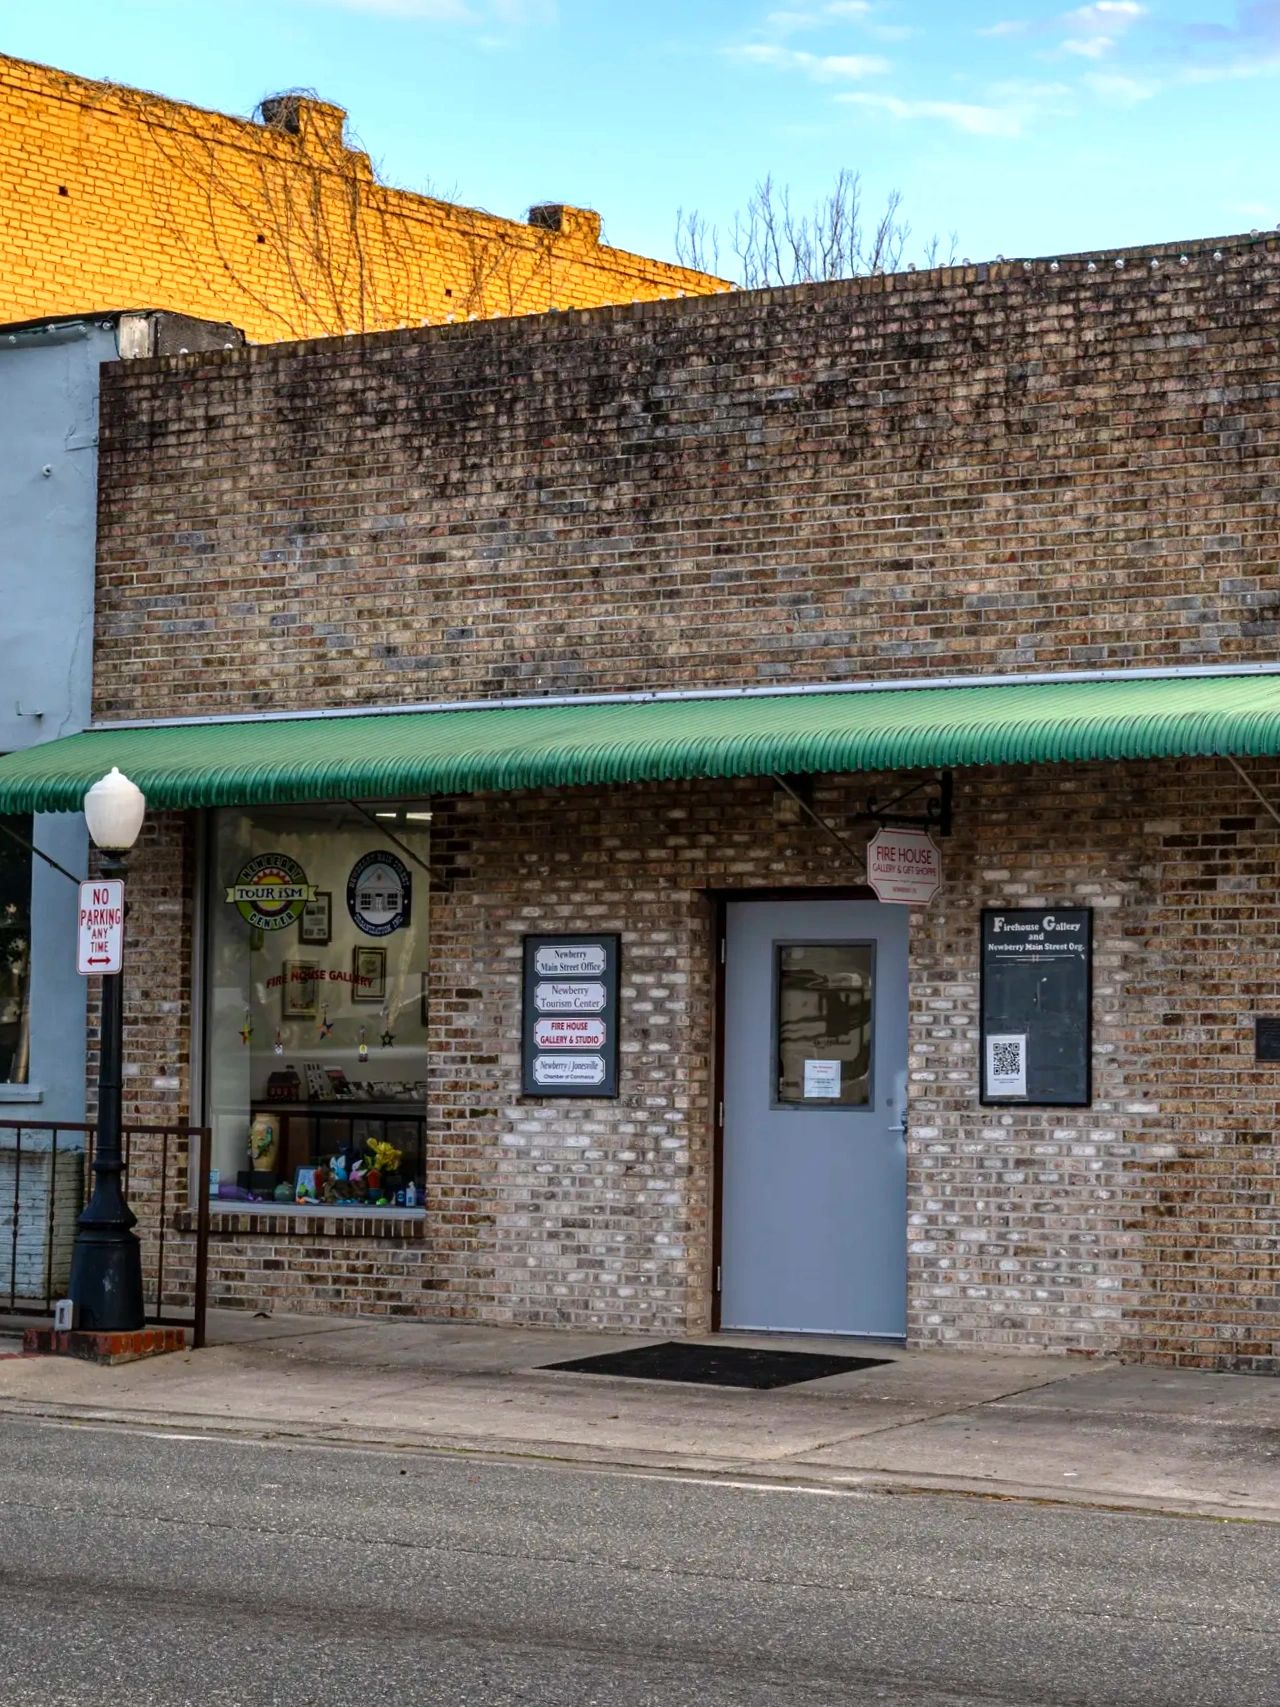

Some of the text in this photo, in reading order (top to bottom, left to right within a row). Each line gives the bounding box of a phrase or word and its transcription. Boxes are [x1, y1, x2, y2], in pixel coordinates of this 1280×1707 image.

[876, 846, 932, 864] FIRE HOUSE
[241, 856, 301, 880] NEWBERRY
[93, 888, 109, 905] NO
[81, 908, 121, 926] PARKING
[249, 911, 295, 929] CENTER
[993, 916, 1081, 932] Firehouse Gallery
[91, 927, 109, 940] ANY
[1028, 932, 1045, 941] and
[90, 941, 109, 953] TIME
[988, 943, 1024, 952] Newberry
[1068, 943, 1085, 952] Org.
[554, 950, 587, 961] Newberry
[541, 962, 601, 972] Main Street Office
[266, 975, 288, 988] FIRE
[329, 970, 374, 988] GALLERY
[551, 985, 589, 997] Newberry
[541, 998, 600, 1008] Tourism Center
[551, 1022, 588, 1030] FIRE HOUSE
[540, 1035, 599, 1044] GALLERY & STUDIO
[541, 1061, 567, 1072] Newberry
